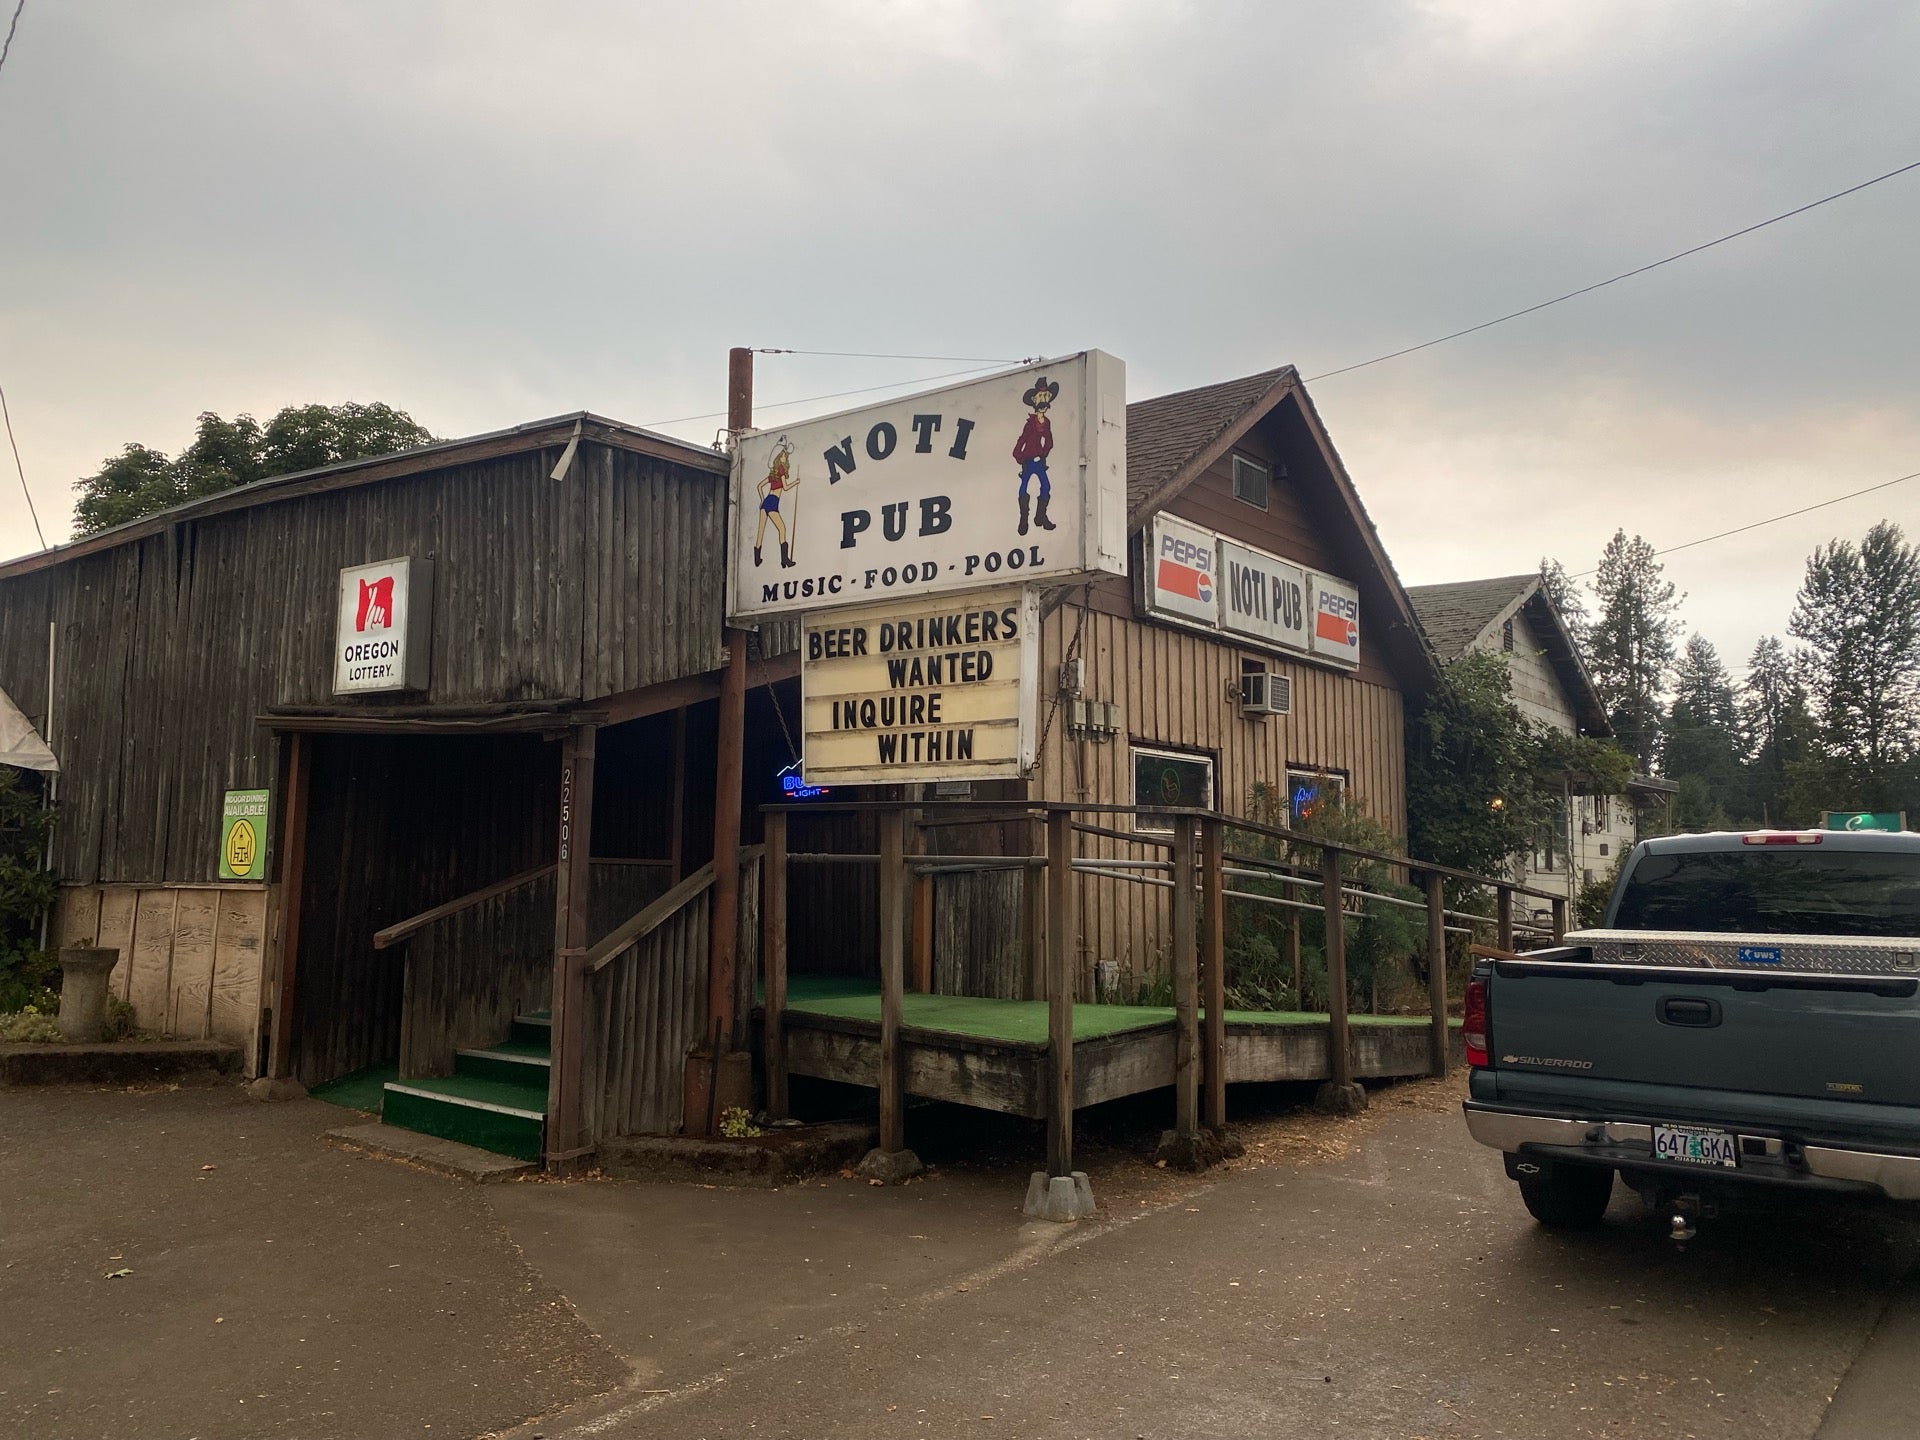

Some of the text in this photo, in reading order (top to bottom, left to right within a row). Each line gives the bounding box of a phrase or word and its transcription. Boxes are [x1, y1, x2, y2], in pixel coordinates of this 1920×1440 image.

[823, 414, 975, 485] NOTI
[840, 495, 952, 549] PUB
[1161, 534, 1212, 572] PEPSI
[762, 545, 1045, 602] MUSIC FOOD POOL
[1229, 561, 1302, 631] NOTI PUB
[1318, 590, 1358, 621] PEPSI
[344, 640, 399, 662] OREGON
[808, 607, 1018, 660] BEER DRINKERS
[887, 650, 993, 688] WANTED
[832, 693, 942, 730] INQUIRE
[877, 729, 974, 763] WITHIN
[783, 776, 812, 790] BU
[793, 788, 821, 797] LIGHT
[224, 804, 266, 816] AVAILABLE!
[561, 769, 571, 860] 22506
[1753, 951, 1775, 959] UWS
[1518, 1056, 1593, 1069] SILVERADO
[1657, 1133, 1733, 1161] 647 GKA
